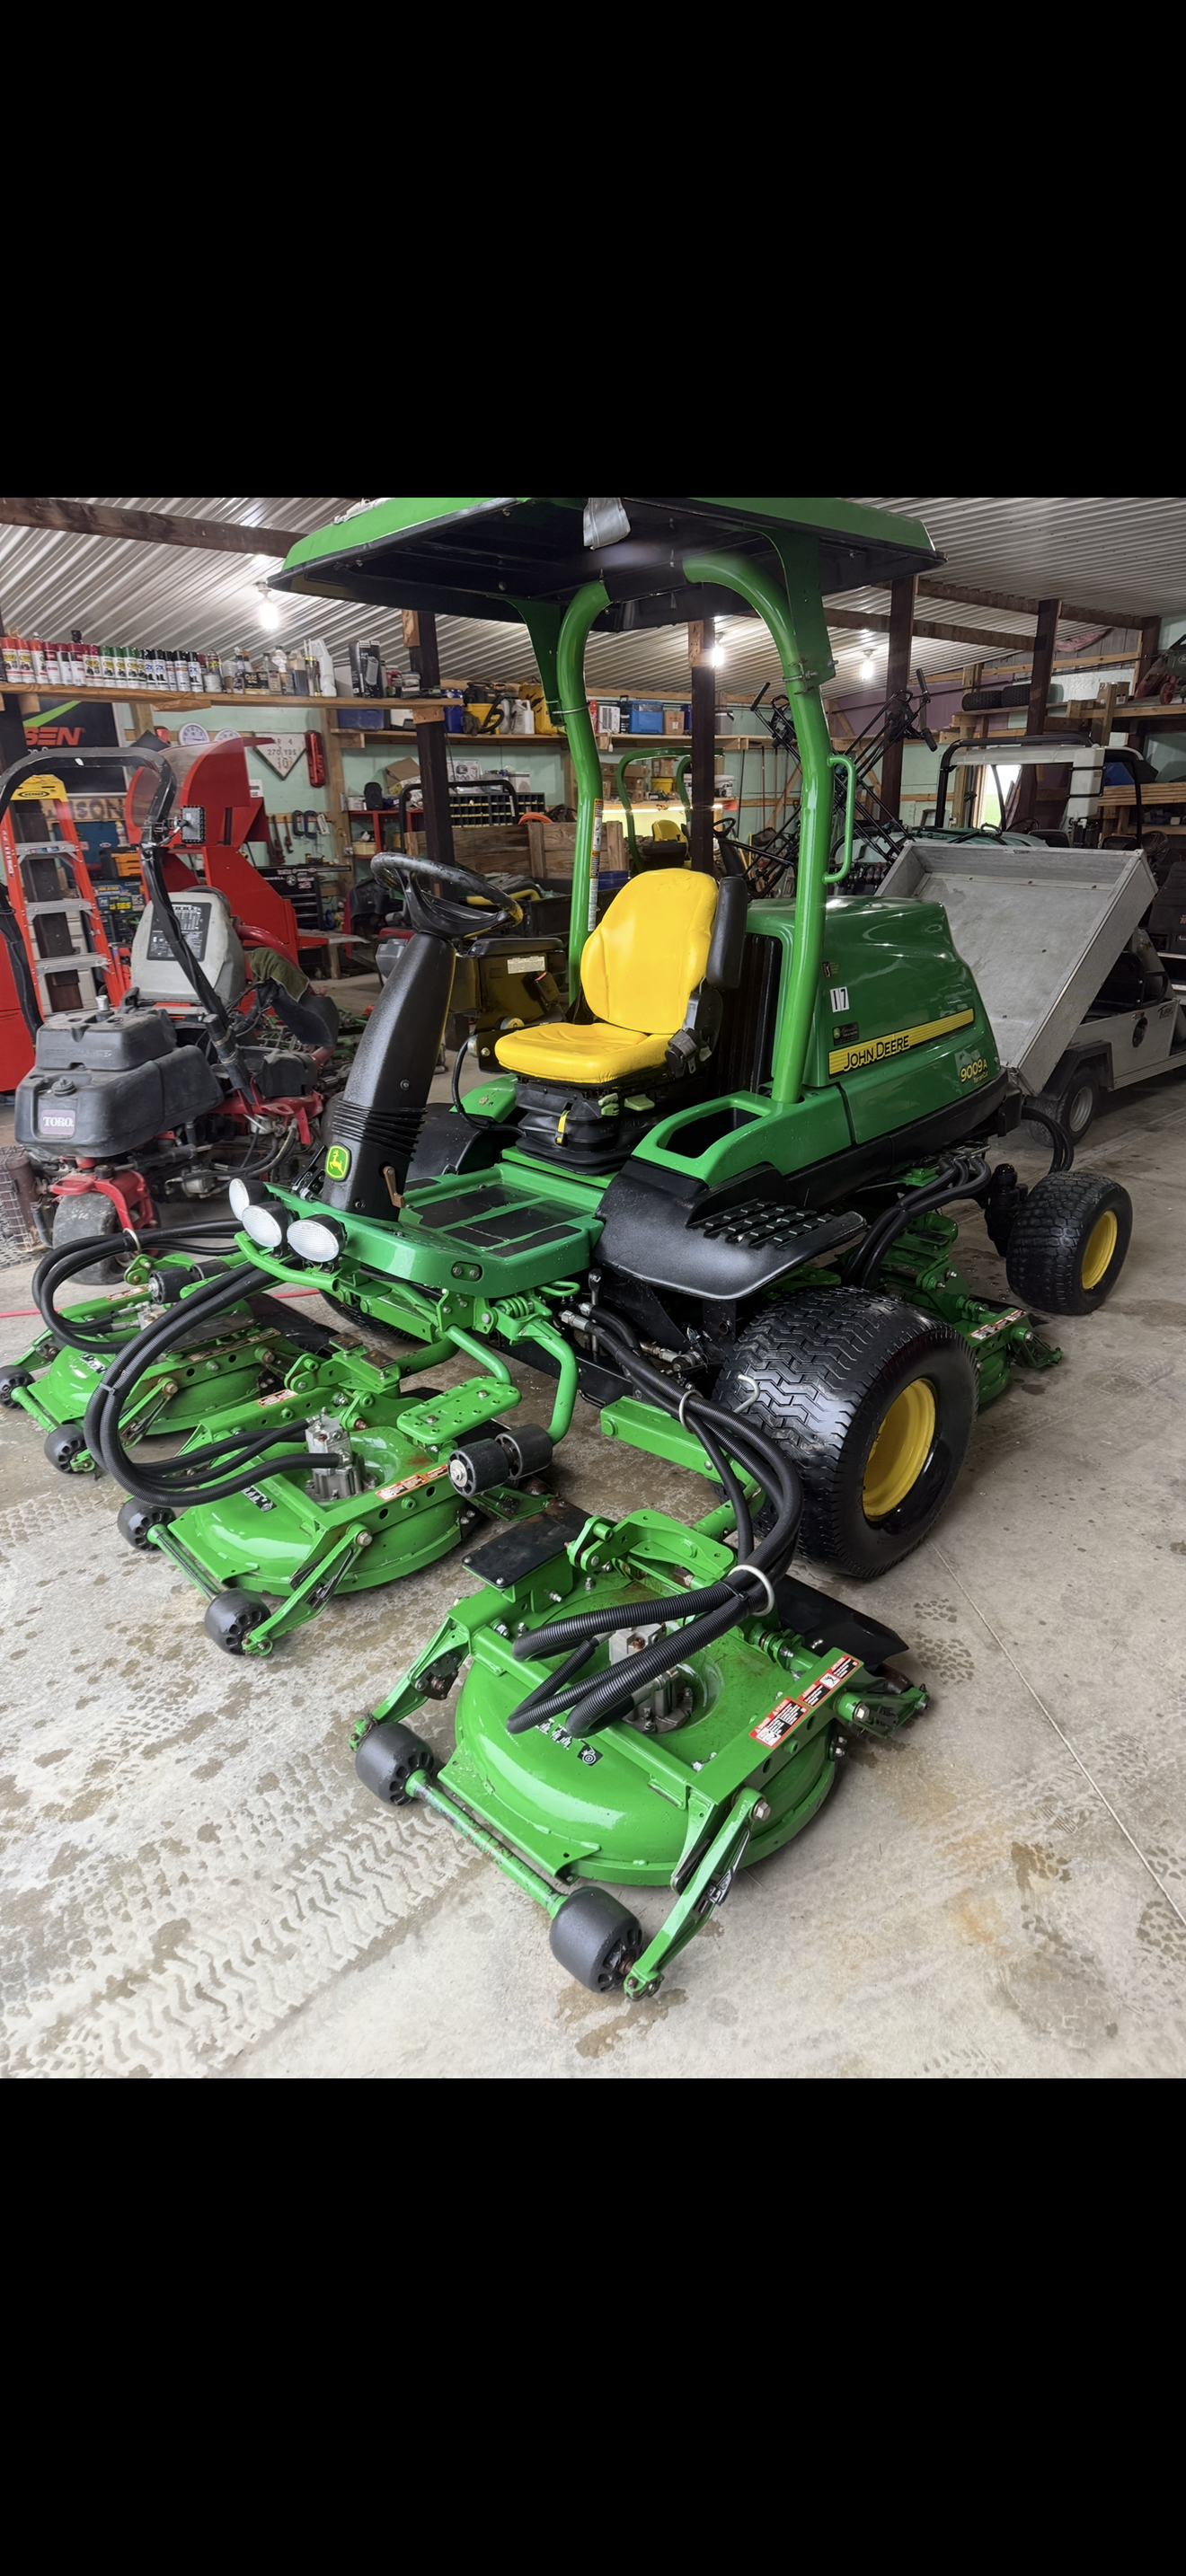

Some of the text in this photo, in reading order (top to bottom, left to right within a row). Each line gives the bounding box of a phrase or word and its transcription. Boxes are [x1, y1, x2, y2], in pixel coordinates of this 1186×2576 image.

[833, 988, 846, 1010] 17
[843, 1035, 910, 1071] JOHN DEERE
[42, 1116, 73, 1127] TORO
